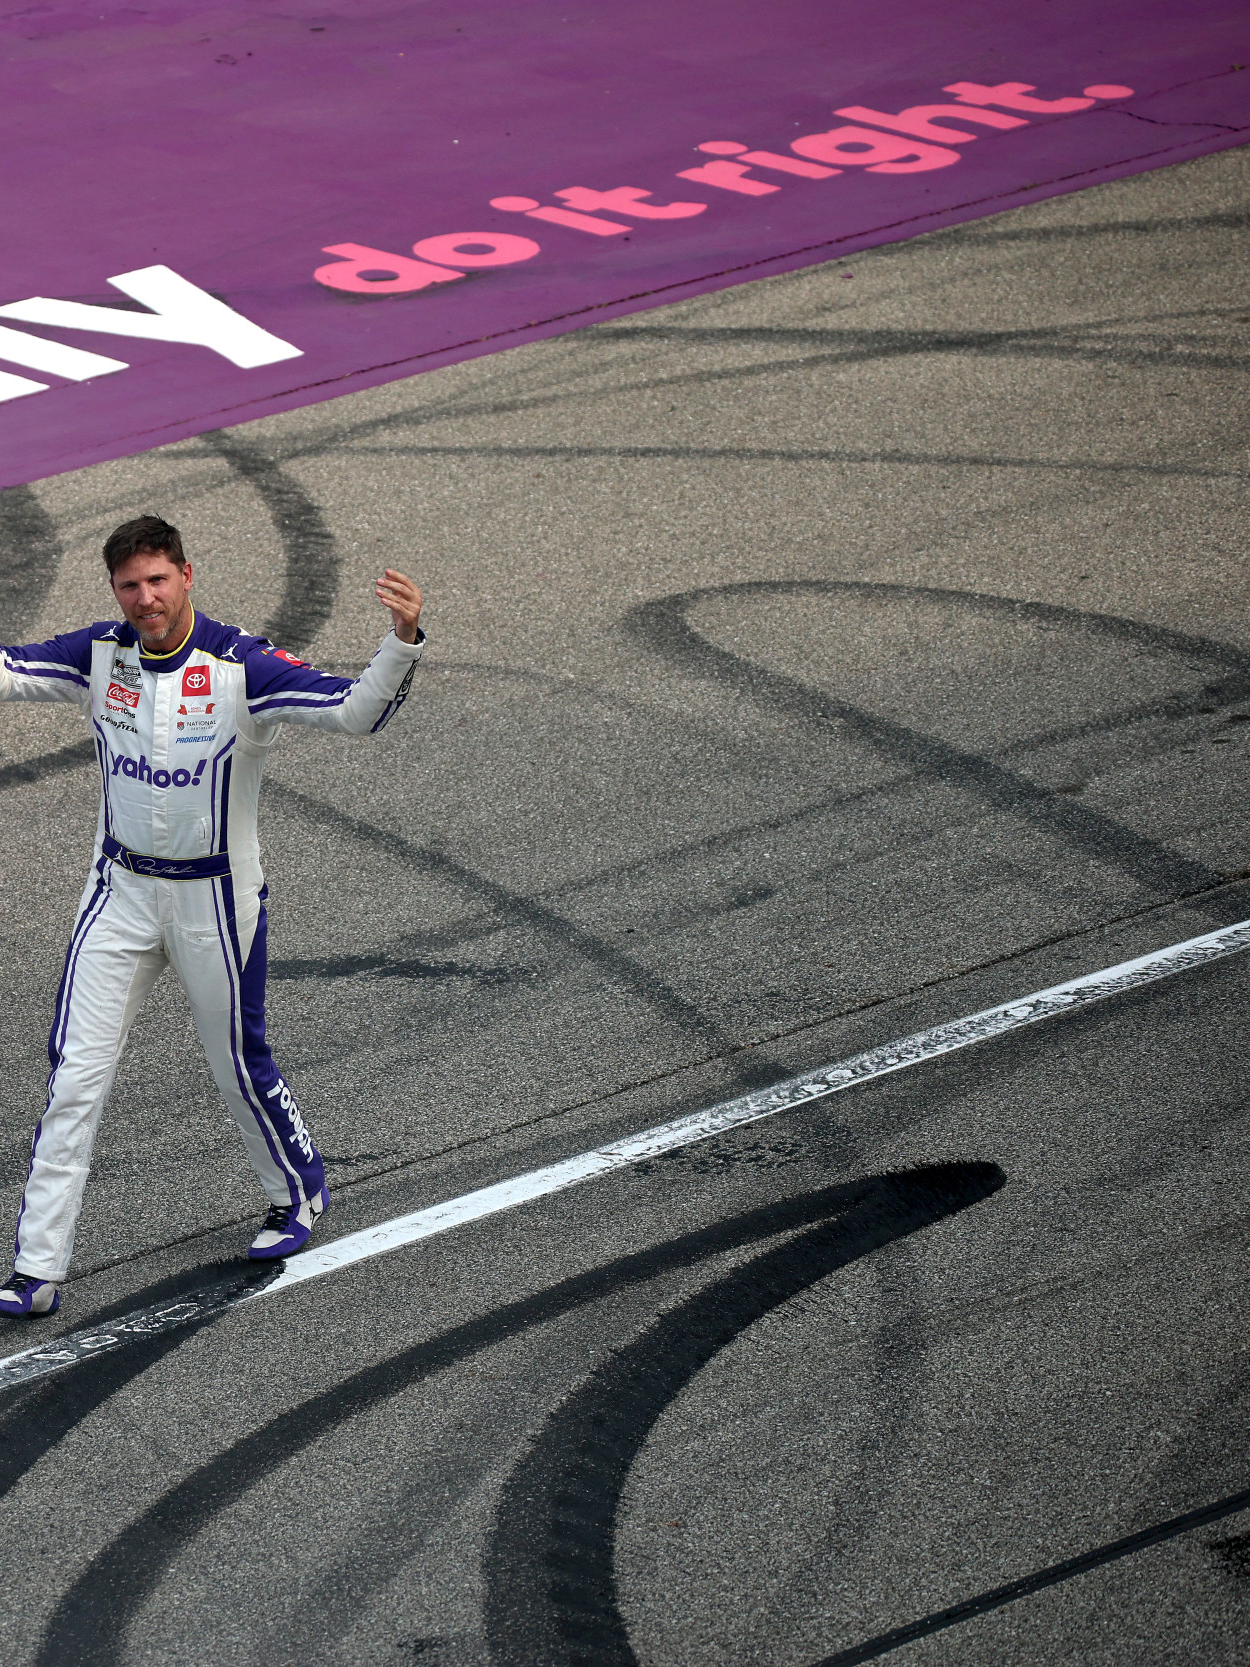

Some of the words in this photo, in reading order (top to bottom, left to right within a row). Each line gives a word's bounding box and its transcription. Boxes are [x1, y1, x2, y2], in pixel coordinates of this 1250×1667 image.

[314, 232, 540, 294] do
[490, 185, 707, 237] it
[677, 81, 1135, 196] right.
[110, 750, 208, 789] yahoo!
